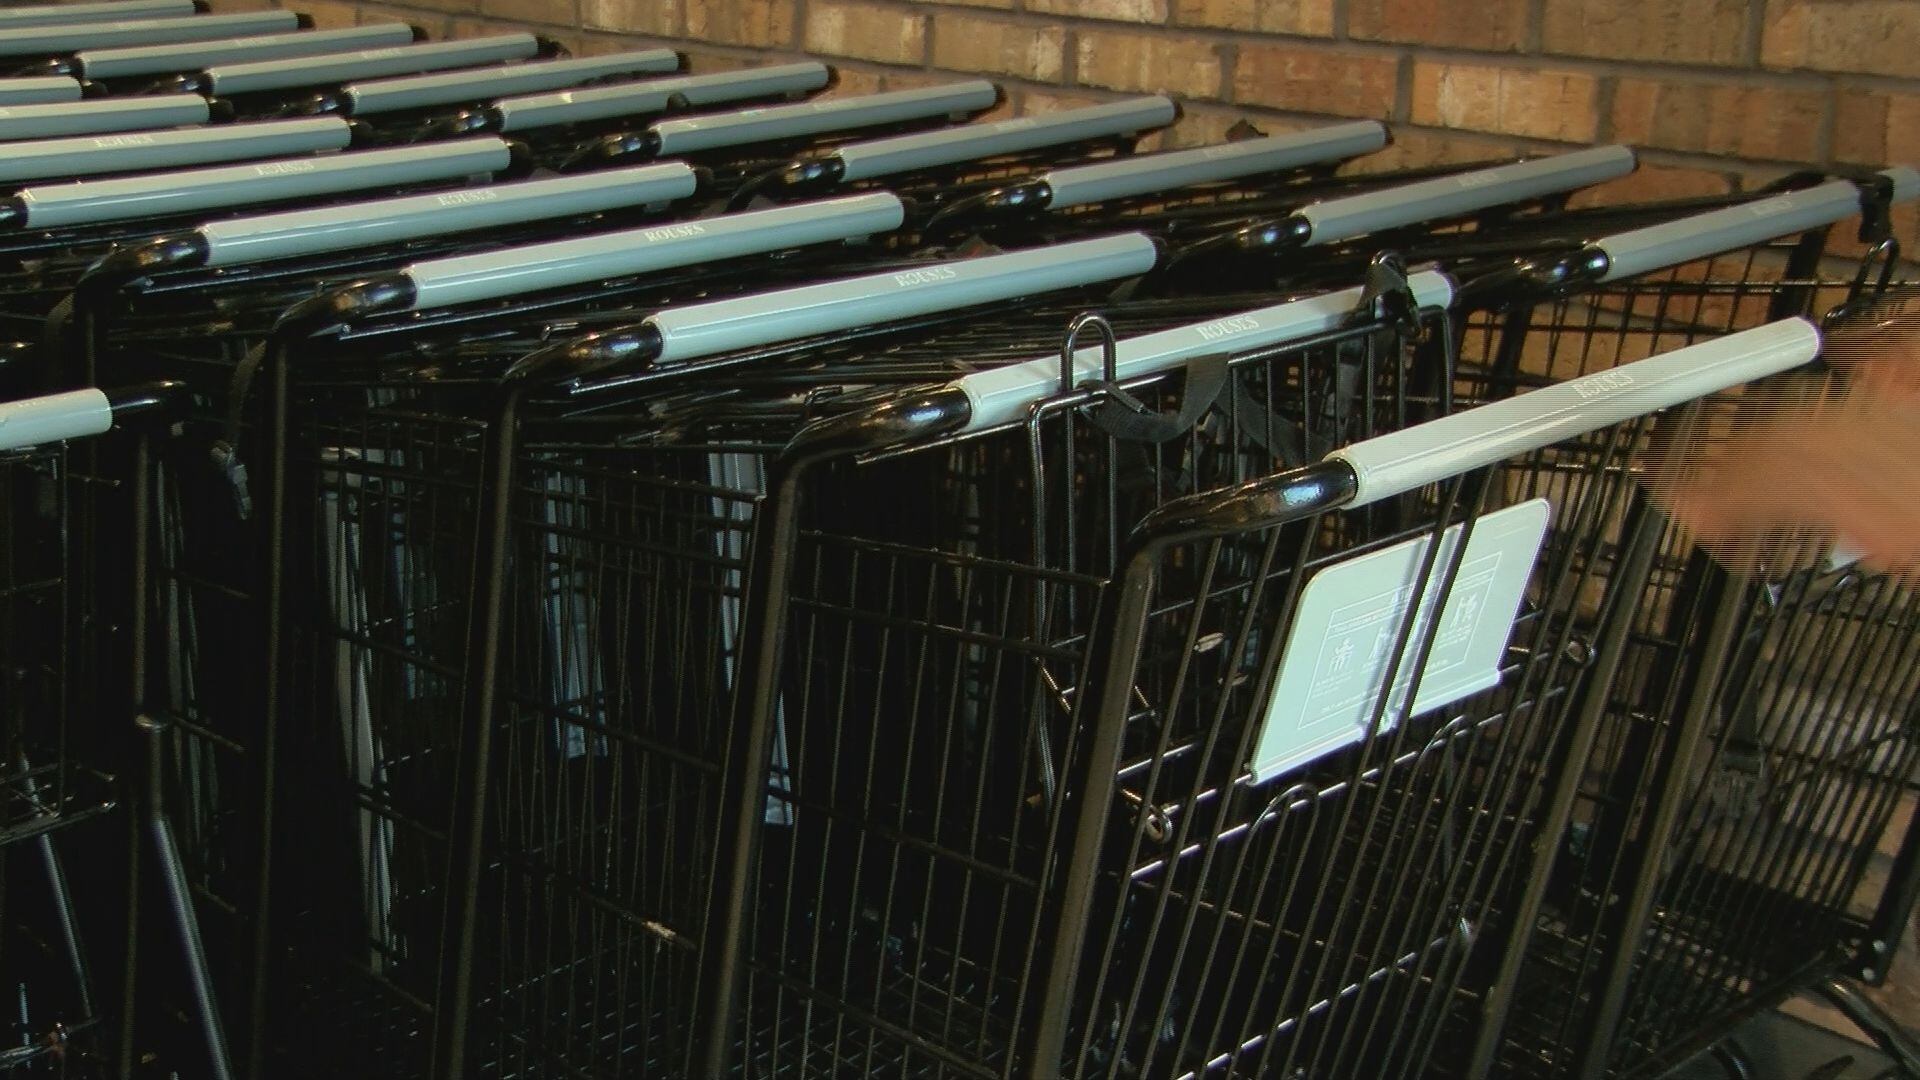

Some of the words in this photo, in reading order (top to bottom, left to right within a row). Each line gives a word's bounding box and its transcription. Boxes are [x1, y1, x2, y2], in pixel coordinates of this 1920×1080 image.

[437, 189, 497, 207] ROUSES
[645, 224, 706, 243] ROUSES
[895, 265, 956, 288] ROUSES
[1196, 315, 1260, 341] ROUSES
[1572, 371, 1635, 400] ROUSES
